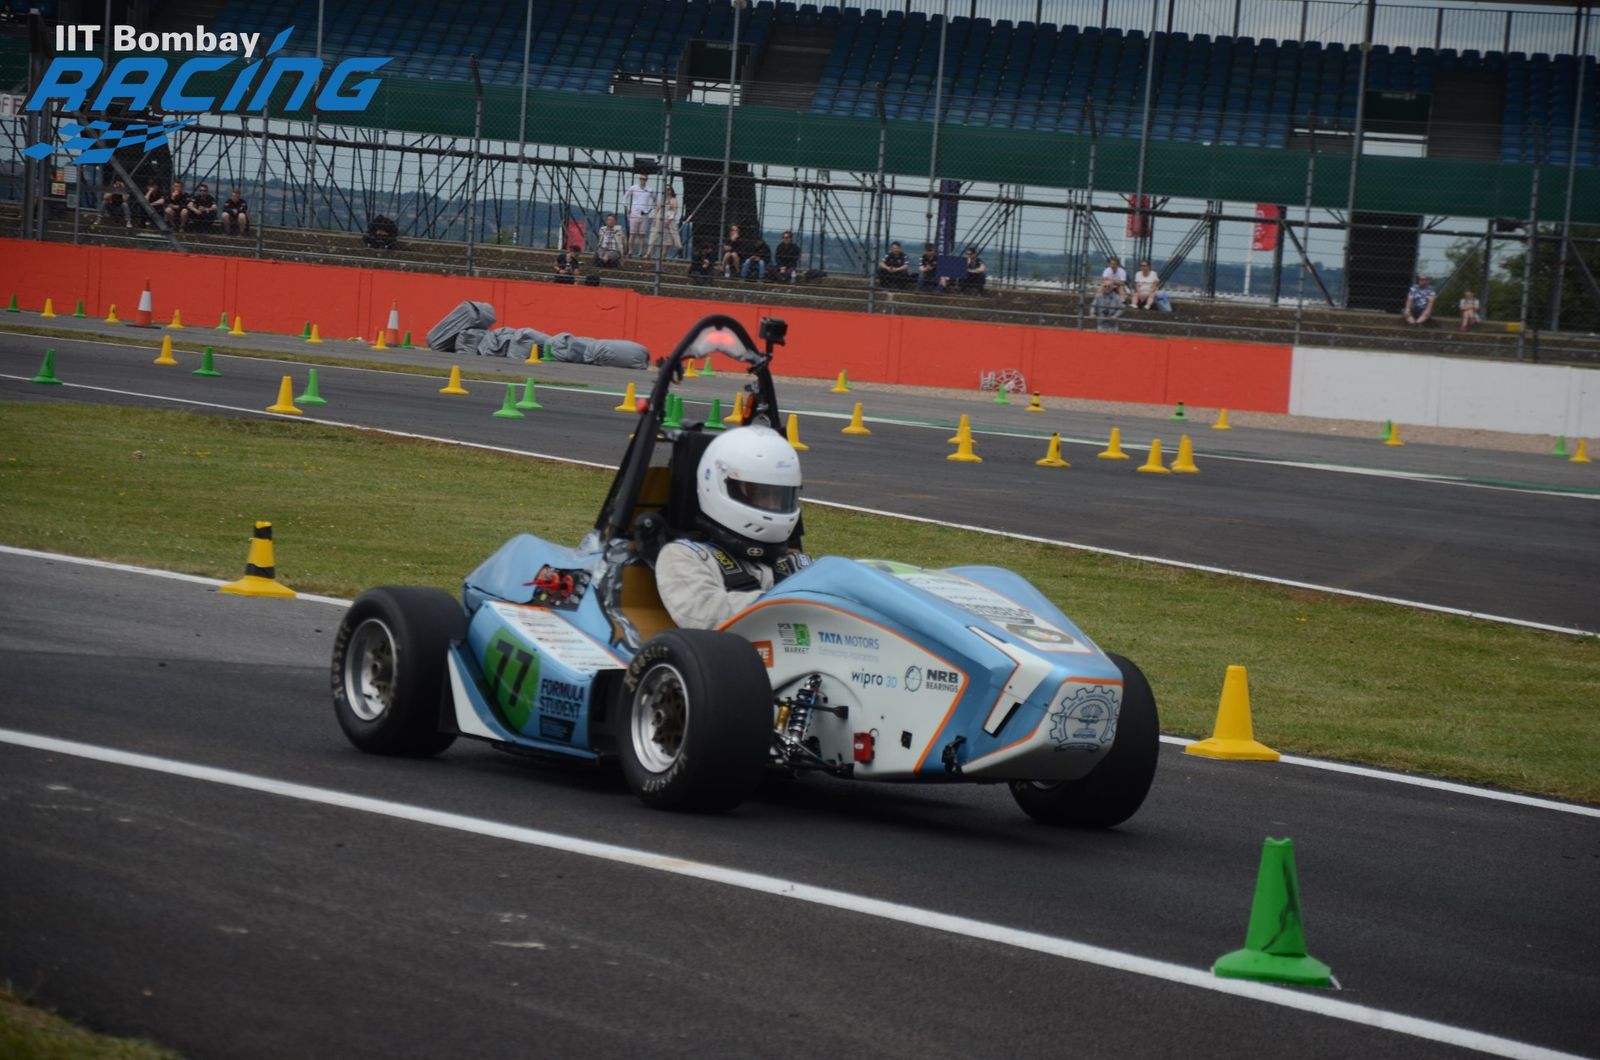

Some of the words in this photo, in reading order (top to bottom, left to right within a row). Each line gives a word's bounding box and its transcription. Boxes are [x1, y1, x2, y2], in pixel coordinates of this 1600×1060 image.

[818, 631, 844, 646] TATA
[844, 634, 880, 650] MOTORS
[490, 639, 535, 707] 77
[851, 668, 883, 688] wipro
[926, 669, 959, 684] NRB
[540, 677, 585, 703] FORMULA
[925, 682, 959, 693] BEARINGS
[538, 696, 582, 720] STUDENT
